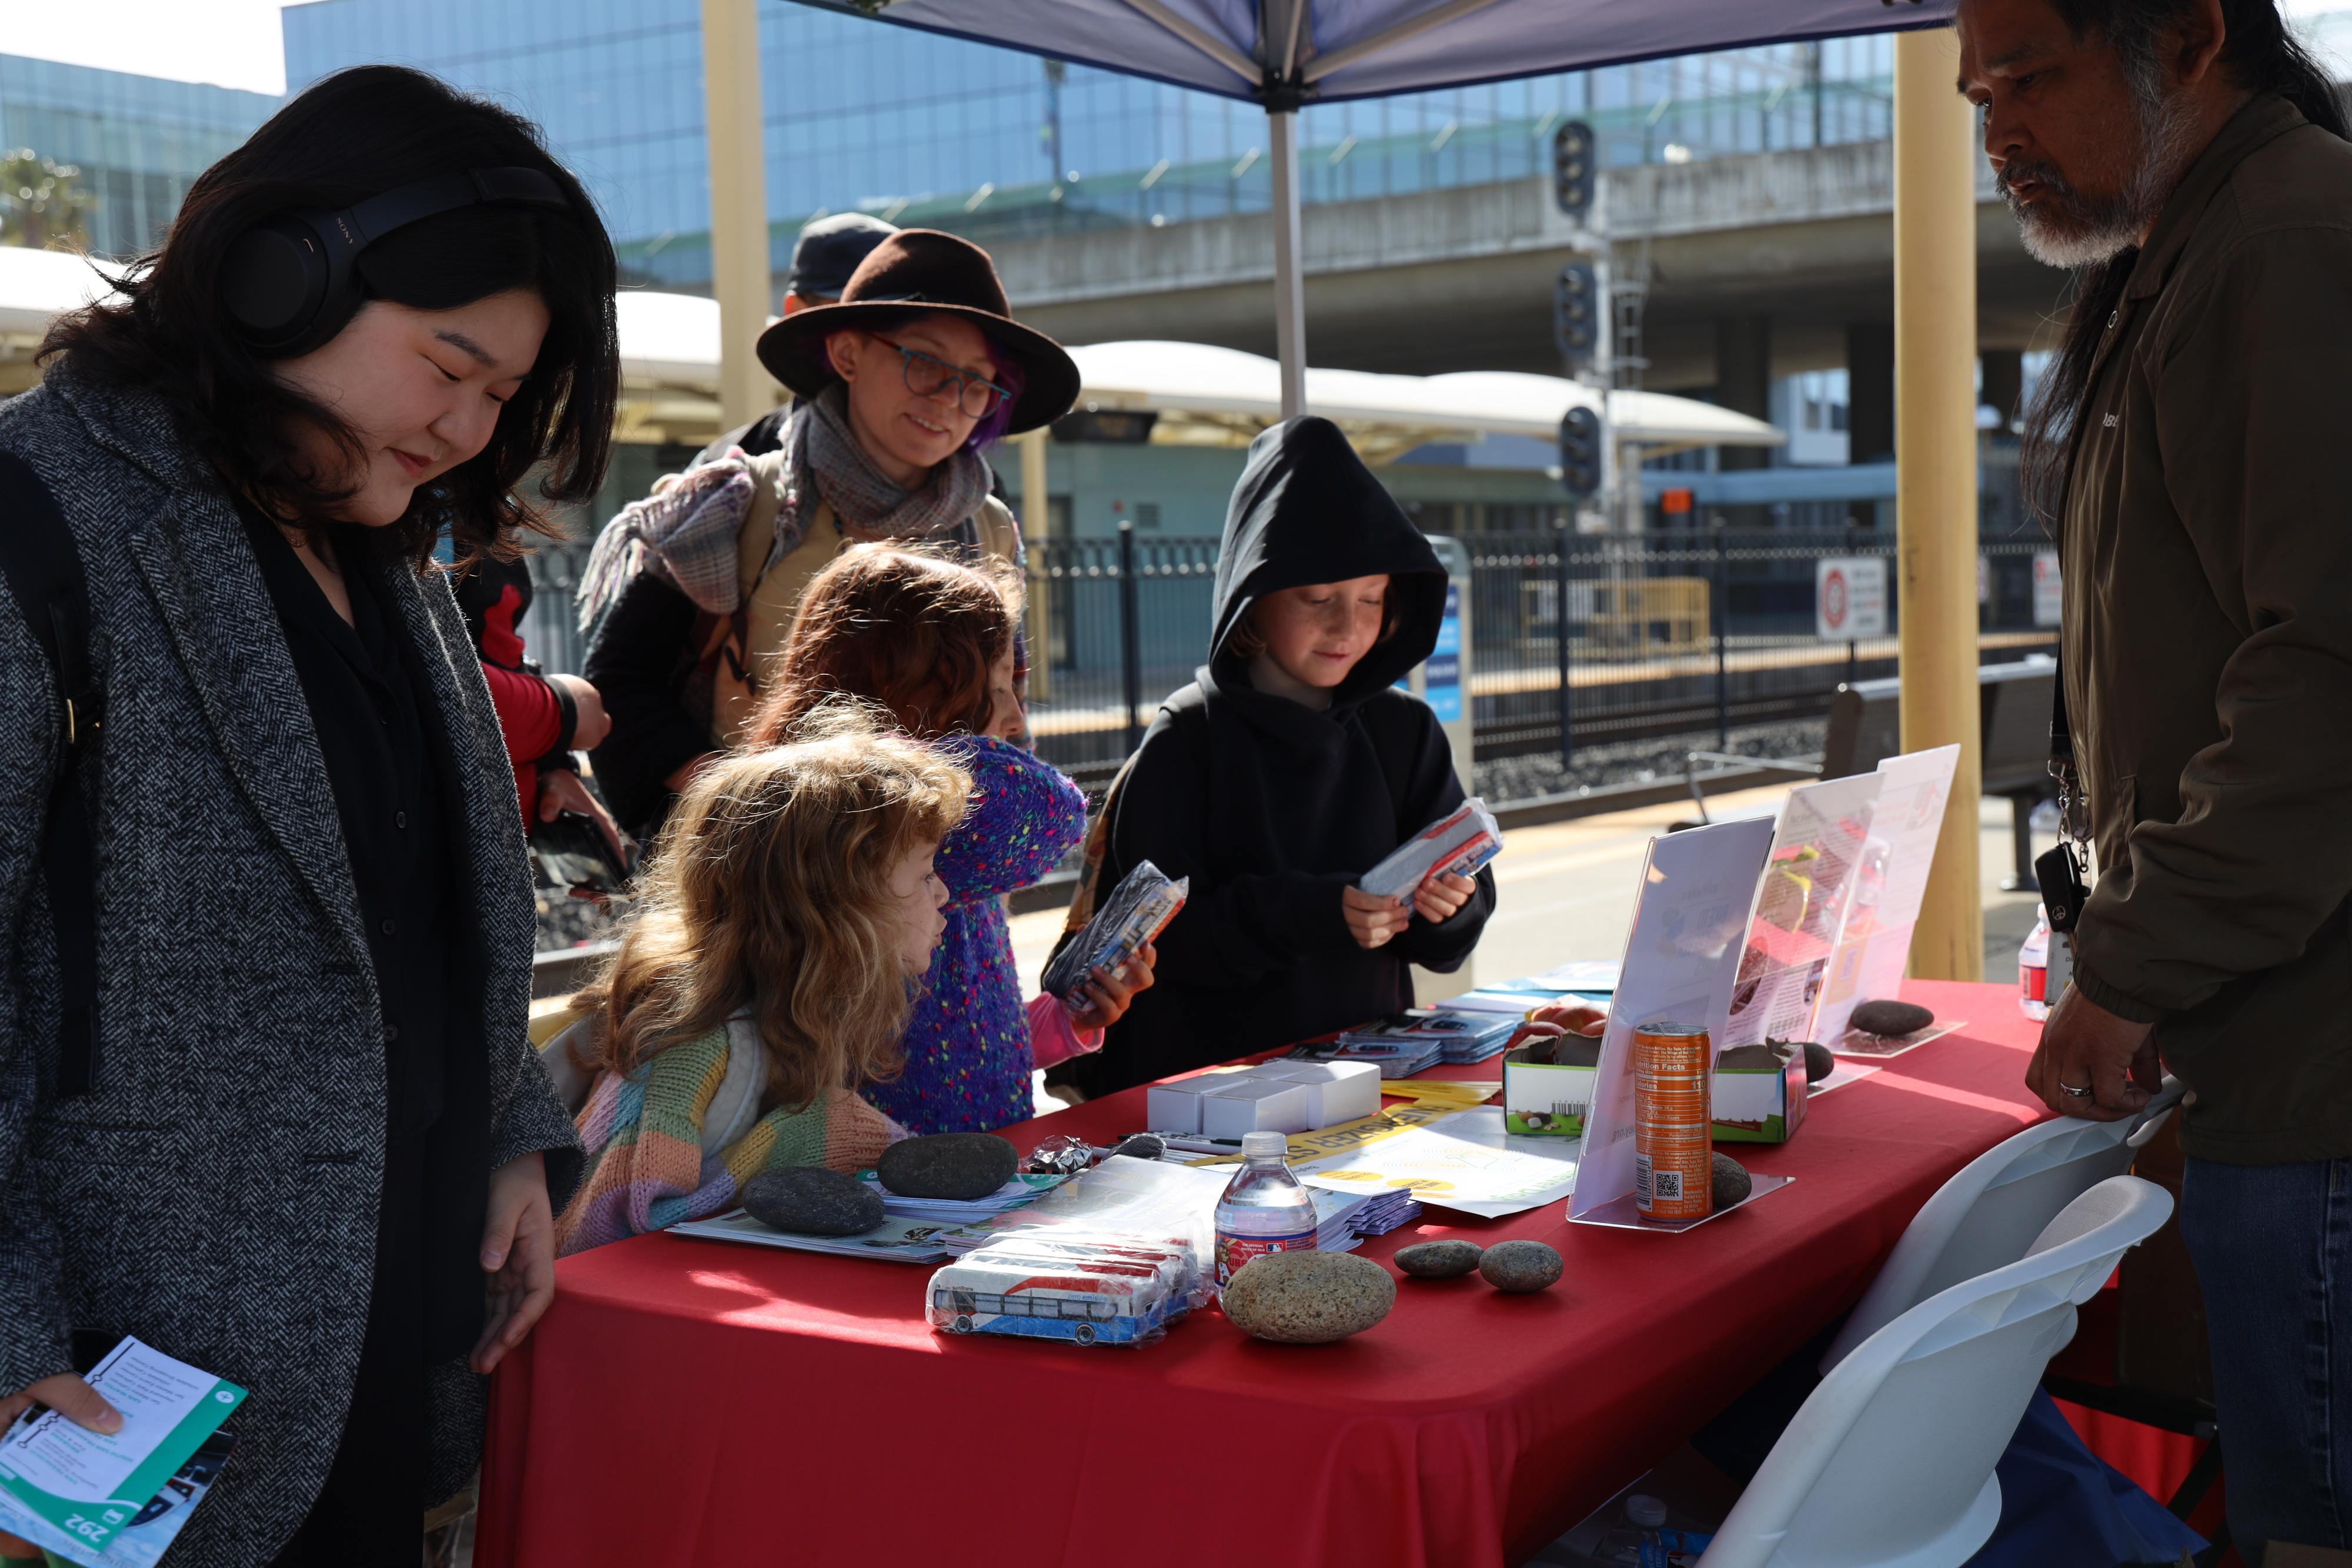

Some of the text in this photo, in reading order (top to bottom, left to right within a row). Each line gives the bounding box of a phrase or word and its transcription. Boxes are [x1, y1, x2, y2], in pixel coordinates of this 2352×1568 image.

[336, 217, 353, 245] SONY
[1692, 1079, 1706, 1089] 110
[64, 1514, 110, 1543] 292
